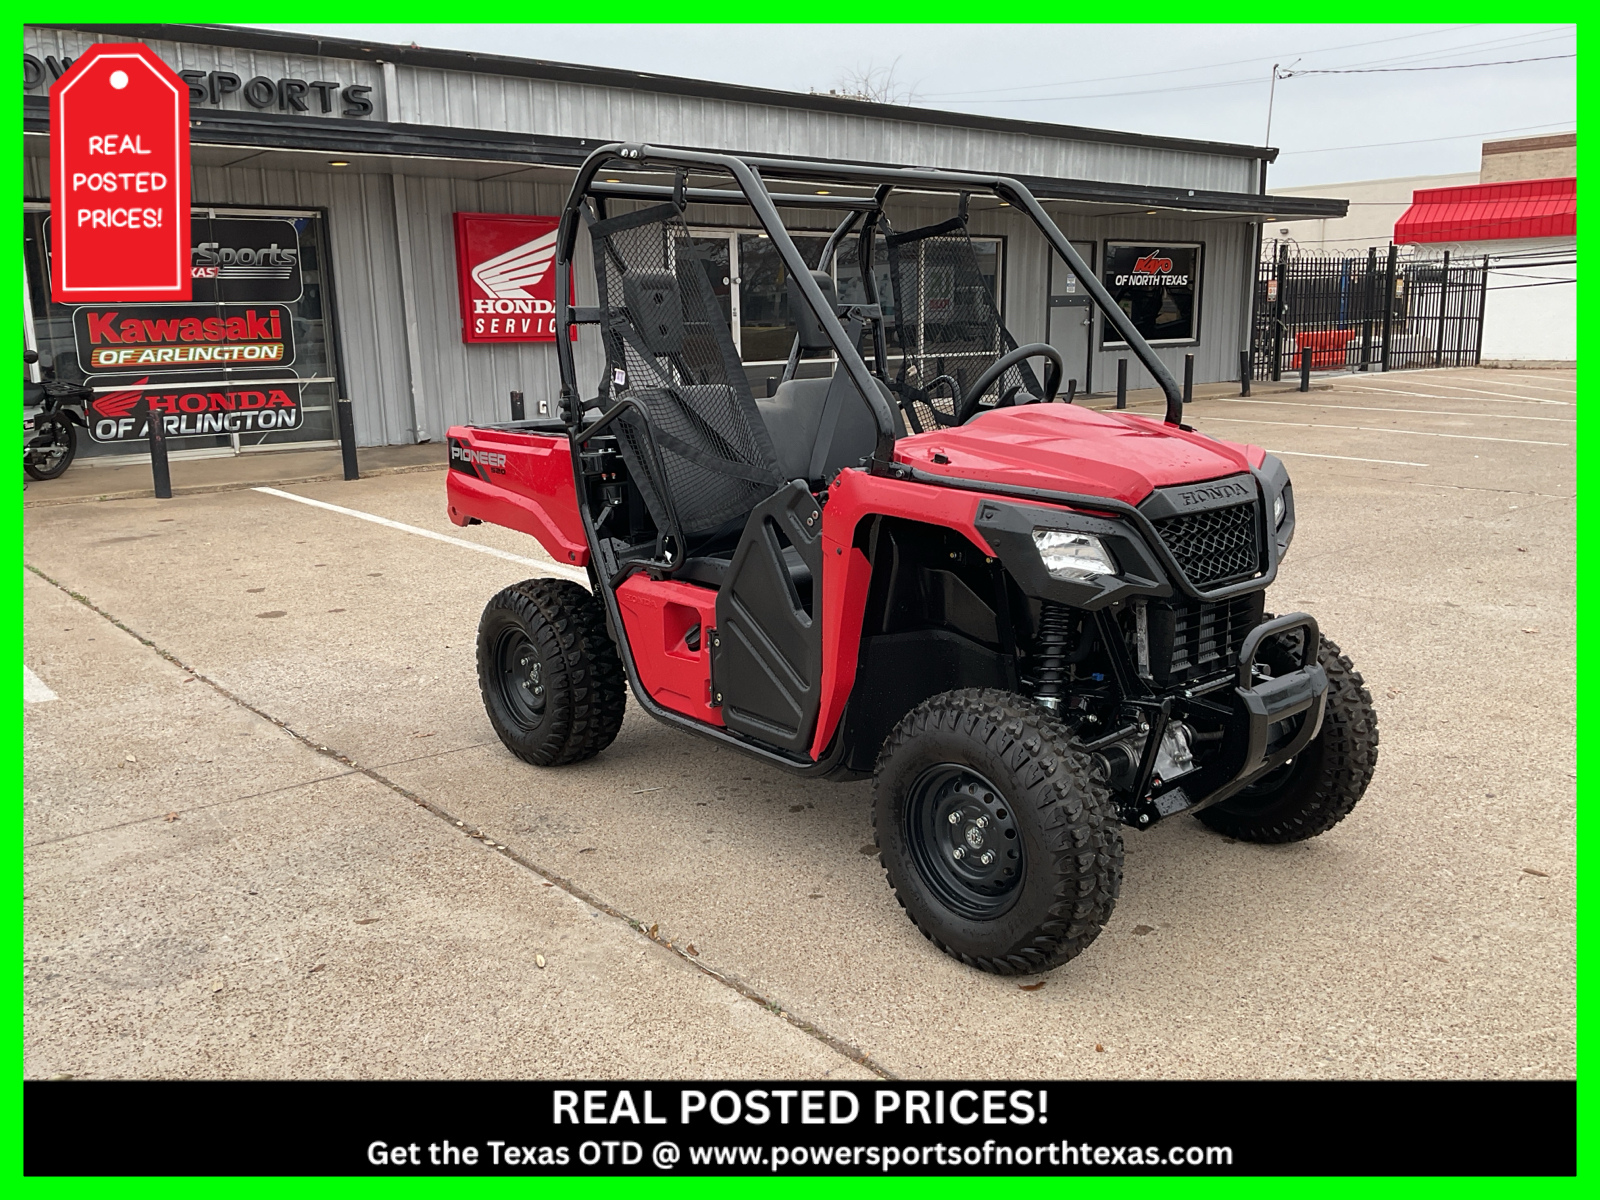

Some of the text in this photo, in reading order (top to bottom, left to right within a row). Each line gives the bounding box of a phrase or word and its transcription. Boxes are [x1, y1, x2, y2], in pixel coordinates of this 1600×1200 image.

[189, 242, 297, 269] rSports
[1115, 274, 1189, 286] OF NORTH TEXAS
[473, 299, 556, 314] HOND
[87, 309, 282, 343] Kawasaki
[475, 317, 556, 334] SERVIC
[99, 345, 278, 365] OF ARLINGTON
[145, 389, 296, 413] HONDA
[95, 417, 136, 440] OF
[451, 446, 507, 468] PIONEER
[491, 466, 506, 475] 520
[1178, 482, 1250, 506] HONDA
